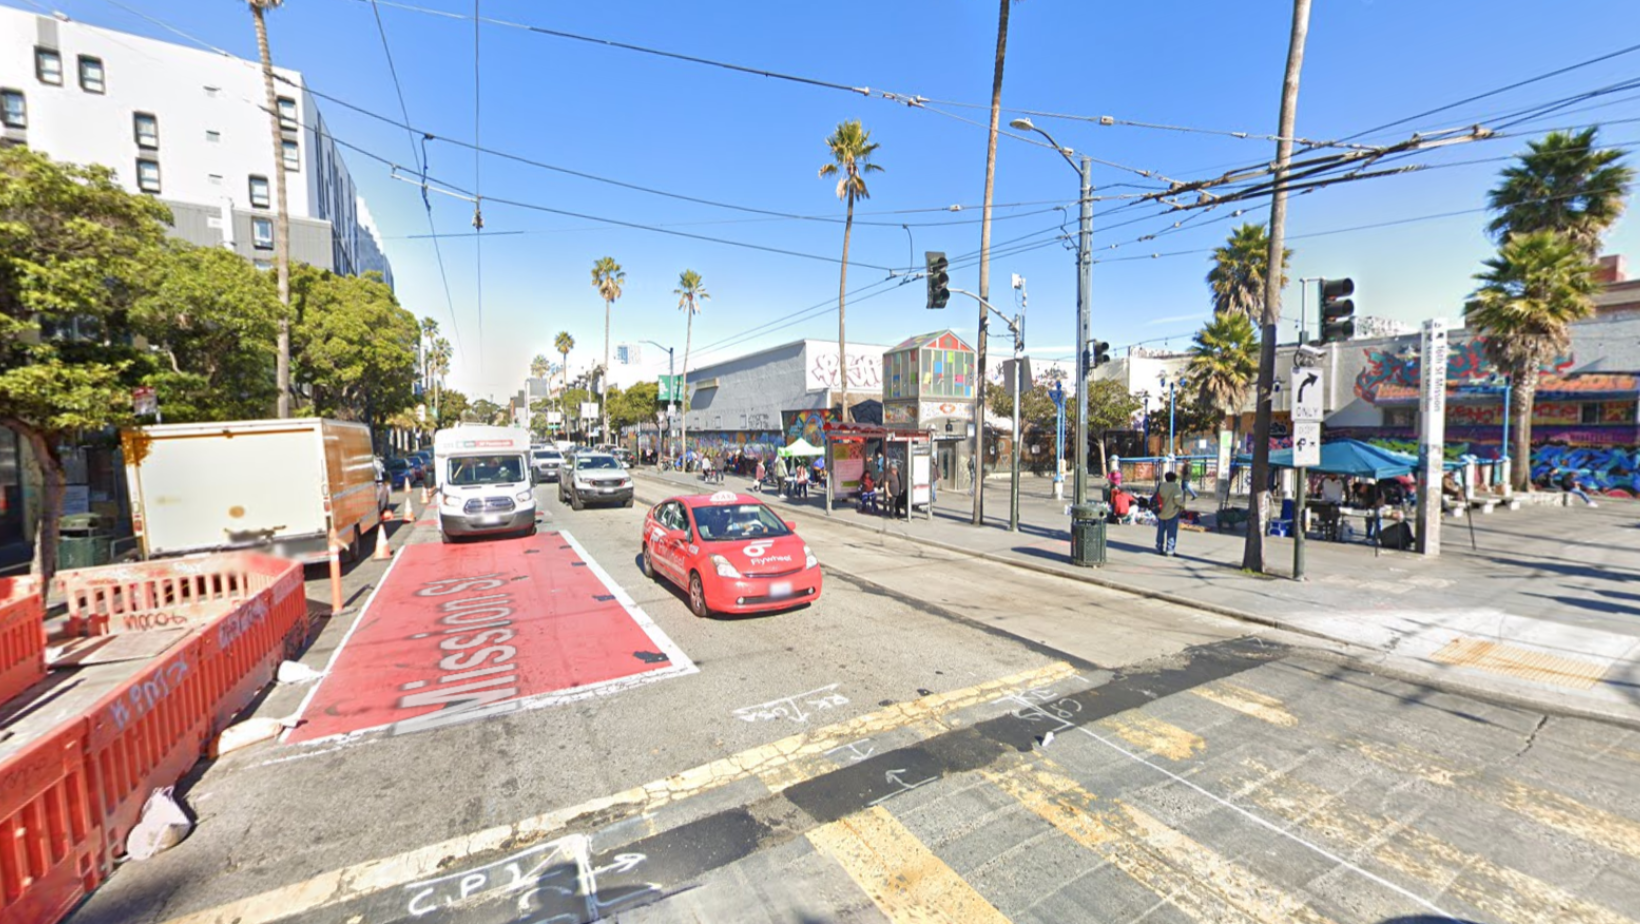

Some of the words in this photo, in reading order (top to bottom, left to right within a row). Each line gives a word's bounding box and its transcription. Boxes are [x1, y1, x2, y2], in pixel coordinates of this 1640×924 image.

[1436, 345, 1445, 363] 16th
[1435, 366, 1443, 375] St
[1434, 378, 1443, 411] Mission
[1296, 407, 1318, 417] ONLY
[750, 555, 792, 566] Flywheel
